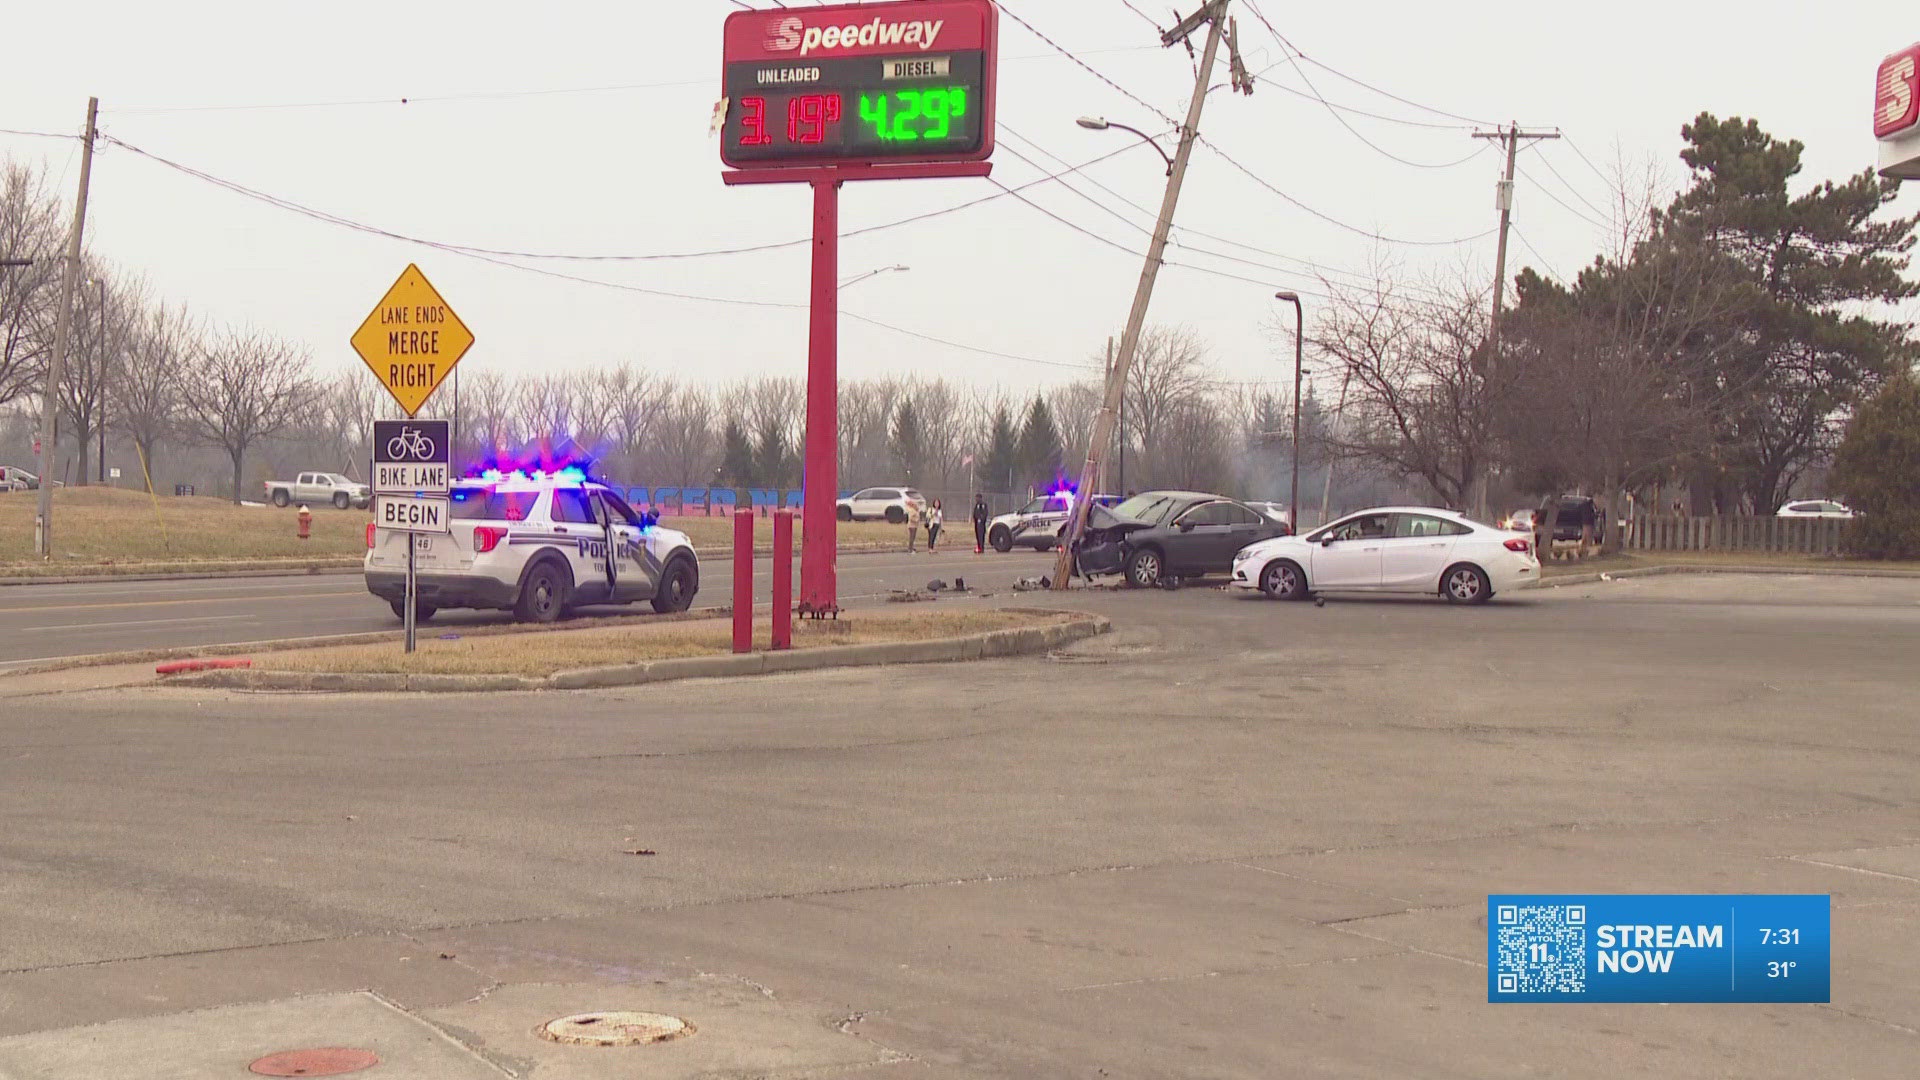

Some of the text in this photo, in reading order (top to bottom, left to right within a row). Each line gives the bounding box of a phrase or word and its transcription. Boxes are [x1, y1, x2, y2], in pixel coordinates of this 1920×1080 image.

[764, 17, 943, 55] Speedway
[757, 67, 820, 83] UNLEADED
[894, 62, 937, 77] DIESEL
[381, 306, 445, 324] LANE ENDS
[388, 331, 439, 354] MERGE
[390, 364, 436, 387] RIGHT
[380, 468, 444, 486] BIKE LANE
[386, 503, 438, 525] BEGIN
[417, 539, 429, 549] 46
